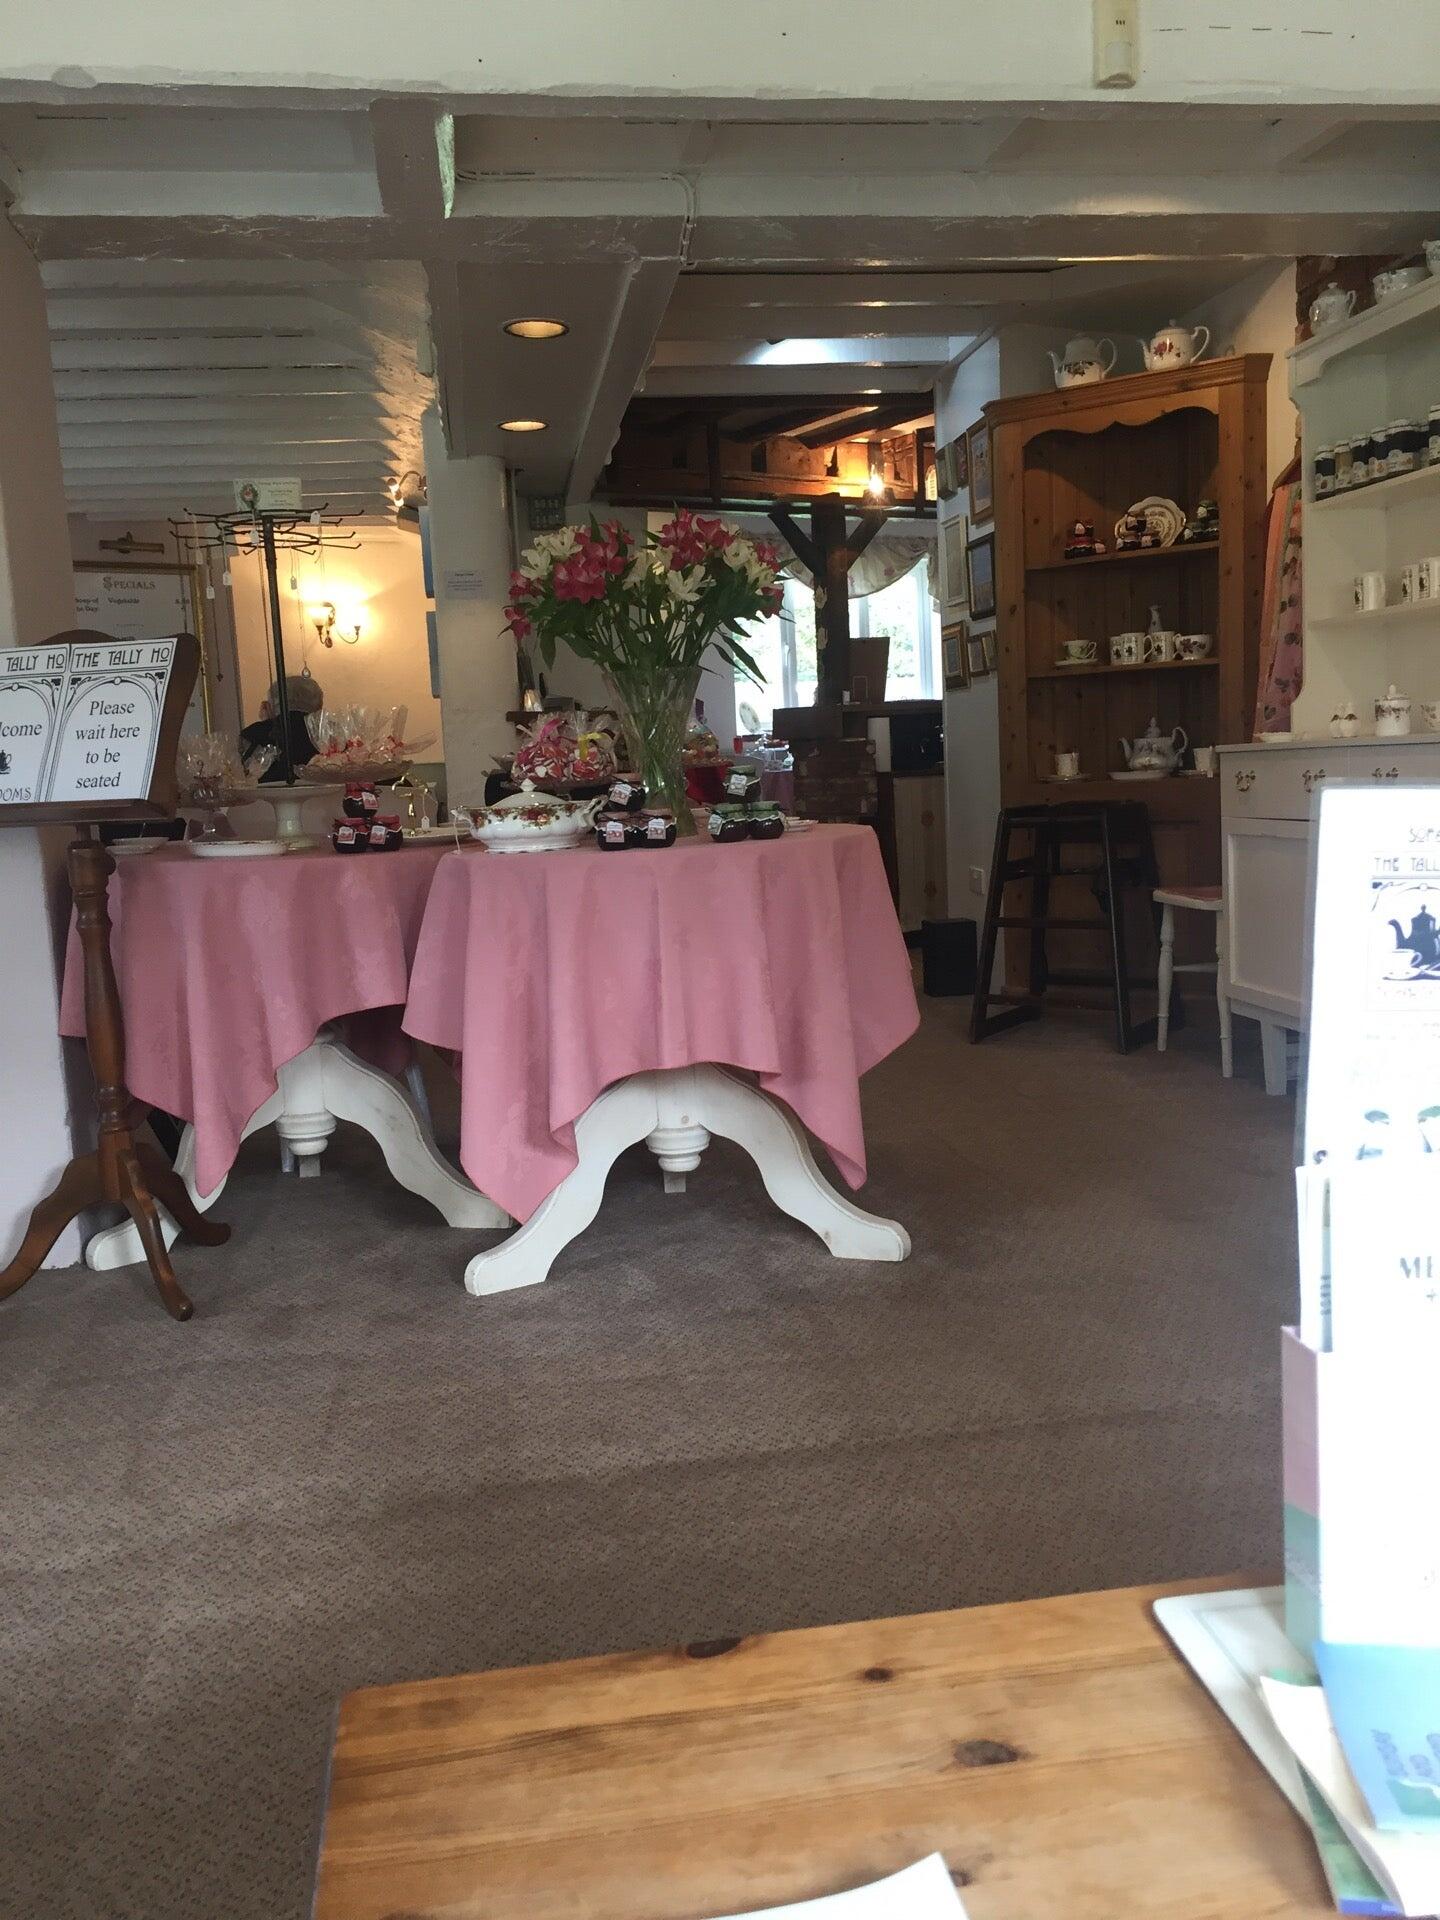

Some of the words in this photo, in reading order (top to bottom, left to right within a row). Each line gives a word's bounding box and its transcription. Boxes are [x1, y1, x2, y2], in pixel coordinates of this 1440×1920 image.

[102, 576, 156, 591] SPECIALS
[6, 655, 39, 672] TALLY
[46, 653, 65, 670] HO
[75, 652, 101, 668] THE
[108, 649, 143, 666] TALLY
[150, 647, 170, 663] HO
[89, 700, 135, 716] Please
[75, 726, 106, 740] wait
[109, 724, 140, 739] here
[86, 751, 99, 764] to
[104, 748, 121, 763] be
[75, 772, 121, 788] seated
[0, 787, 32, 801] OMS
[1374, 857, 1400, 872] THE
